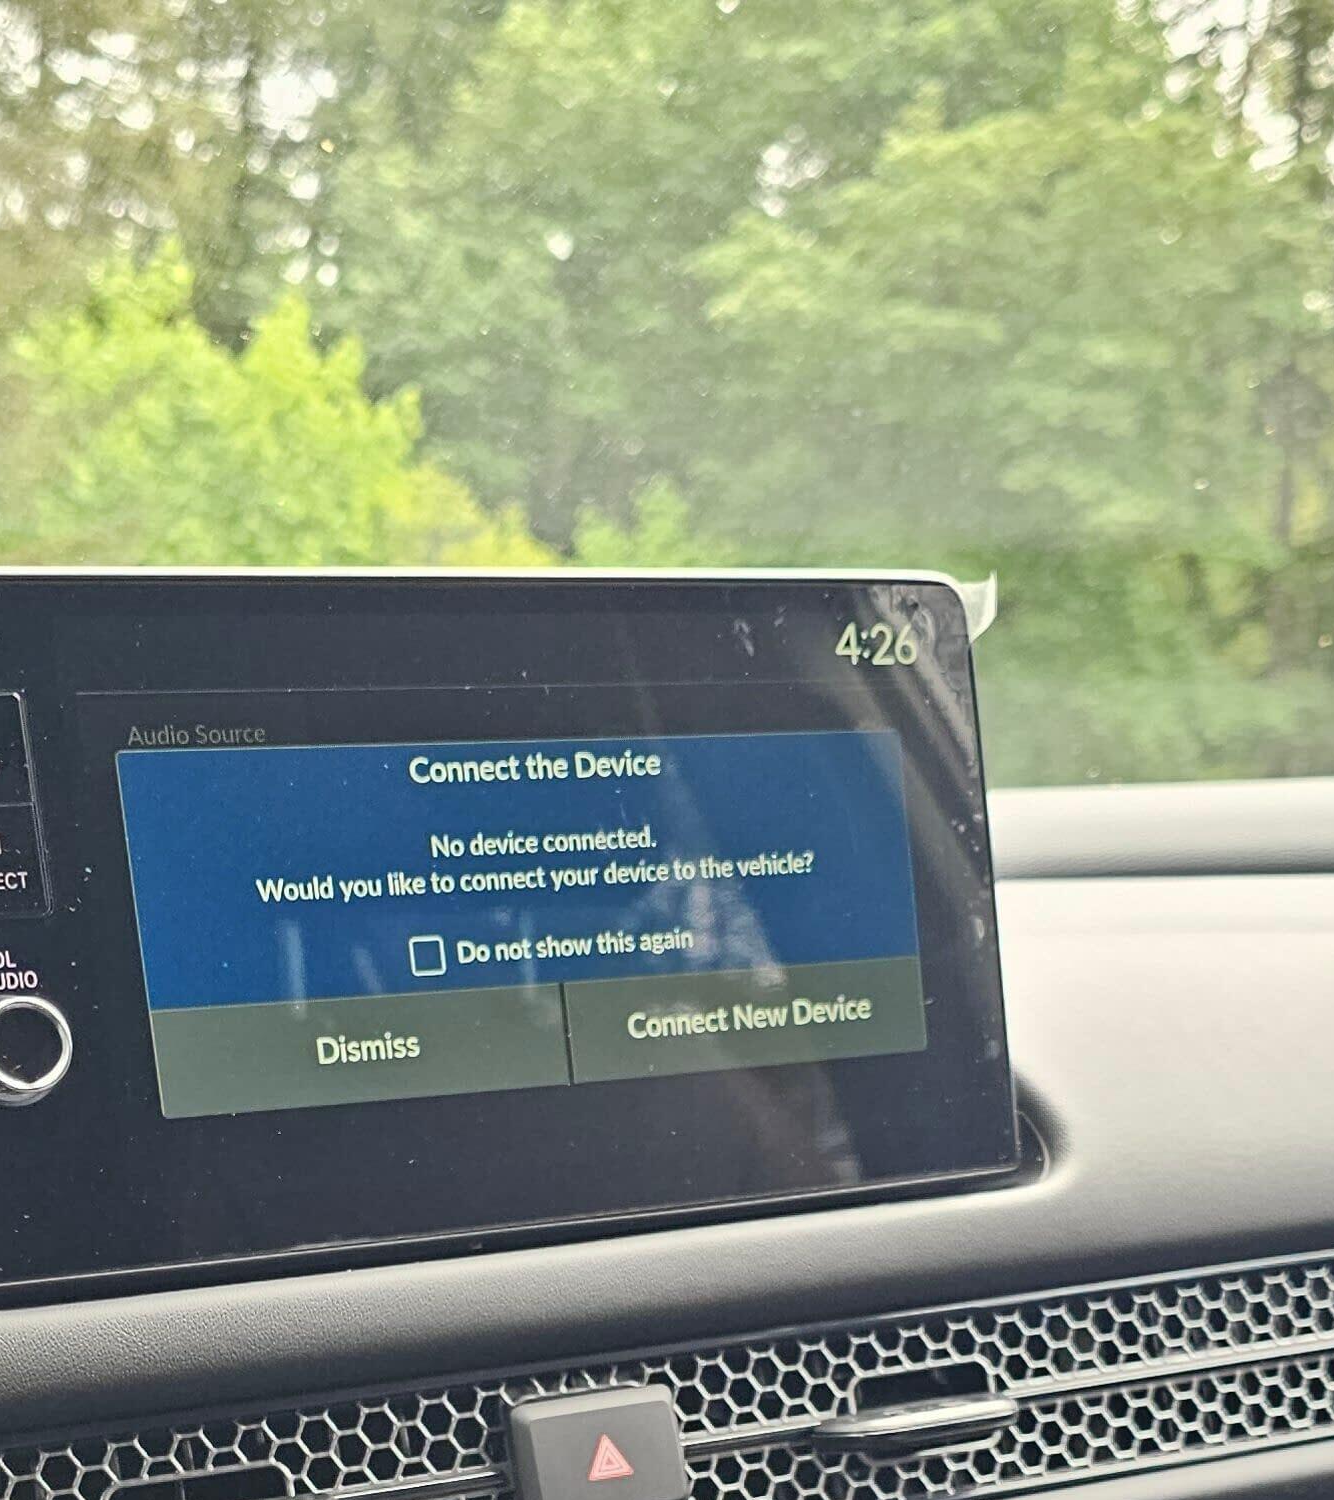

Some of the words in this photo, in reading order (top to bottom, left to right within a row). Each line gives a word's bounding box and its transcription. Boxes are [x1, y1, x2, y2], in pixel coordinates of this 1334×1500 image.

[835, 622, 918, 666] 4:26
[128, 725, 189, 747] Audio
[195, 725, 266, 746] Source
[409, 753, 520, 784] Connect
[524, 752, 569, 780] the
[574, 749, 662, 778] Device
[430, 834, 465, 858] No
[469, 830, 539, 857] device
[542, 824, 657, 854] connected.
[255, 874, 334, 903] Would
[339, 877, 383, 903] you
[387, 871, 426, 897] like
[430, 872, 455, 894] to
[459, 866, 546, 893] connect
[550, 867, 599, 892] your
[603, 859, 669, 885] device
[673, 857, 697, 881] to
[699, 854, 734, 879] the
[738, 850, 815, 877] vehicle?
[456, 940, 490, 965] Do
[494, 937, 532, 962] not
[535, 933, 593, 959] show
[596, 928, 636, 955] this
[639, 926, 695, 955] again
[627, 1007, 730, 1040] Connect
[733, 1001, 788, 1031] New
[793, 994, 873, 1025] Device
[316, 1032, 421, 1066] Dismiss
